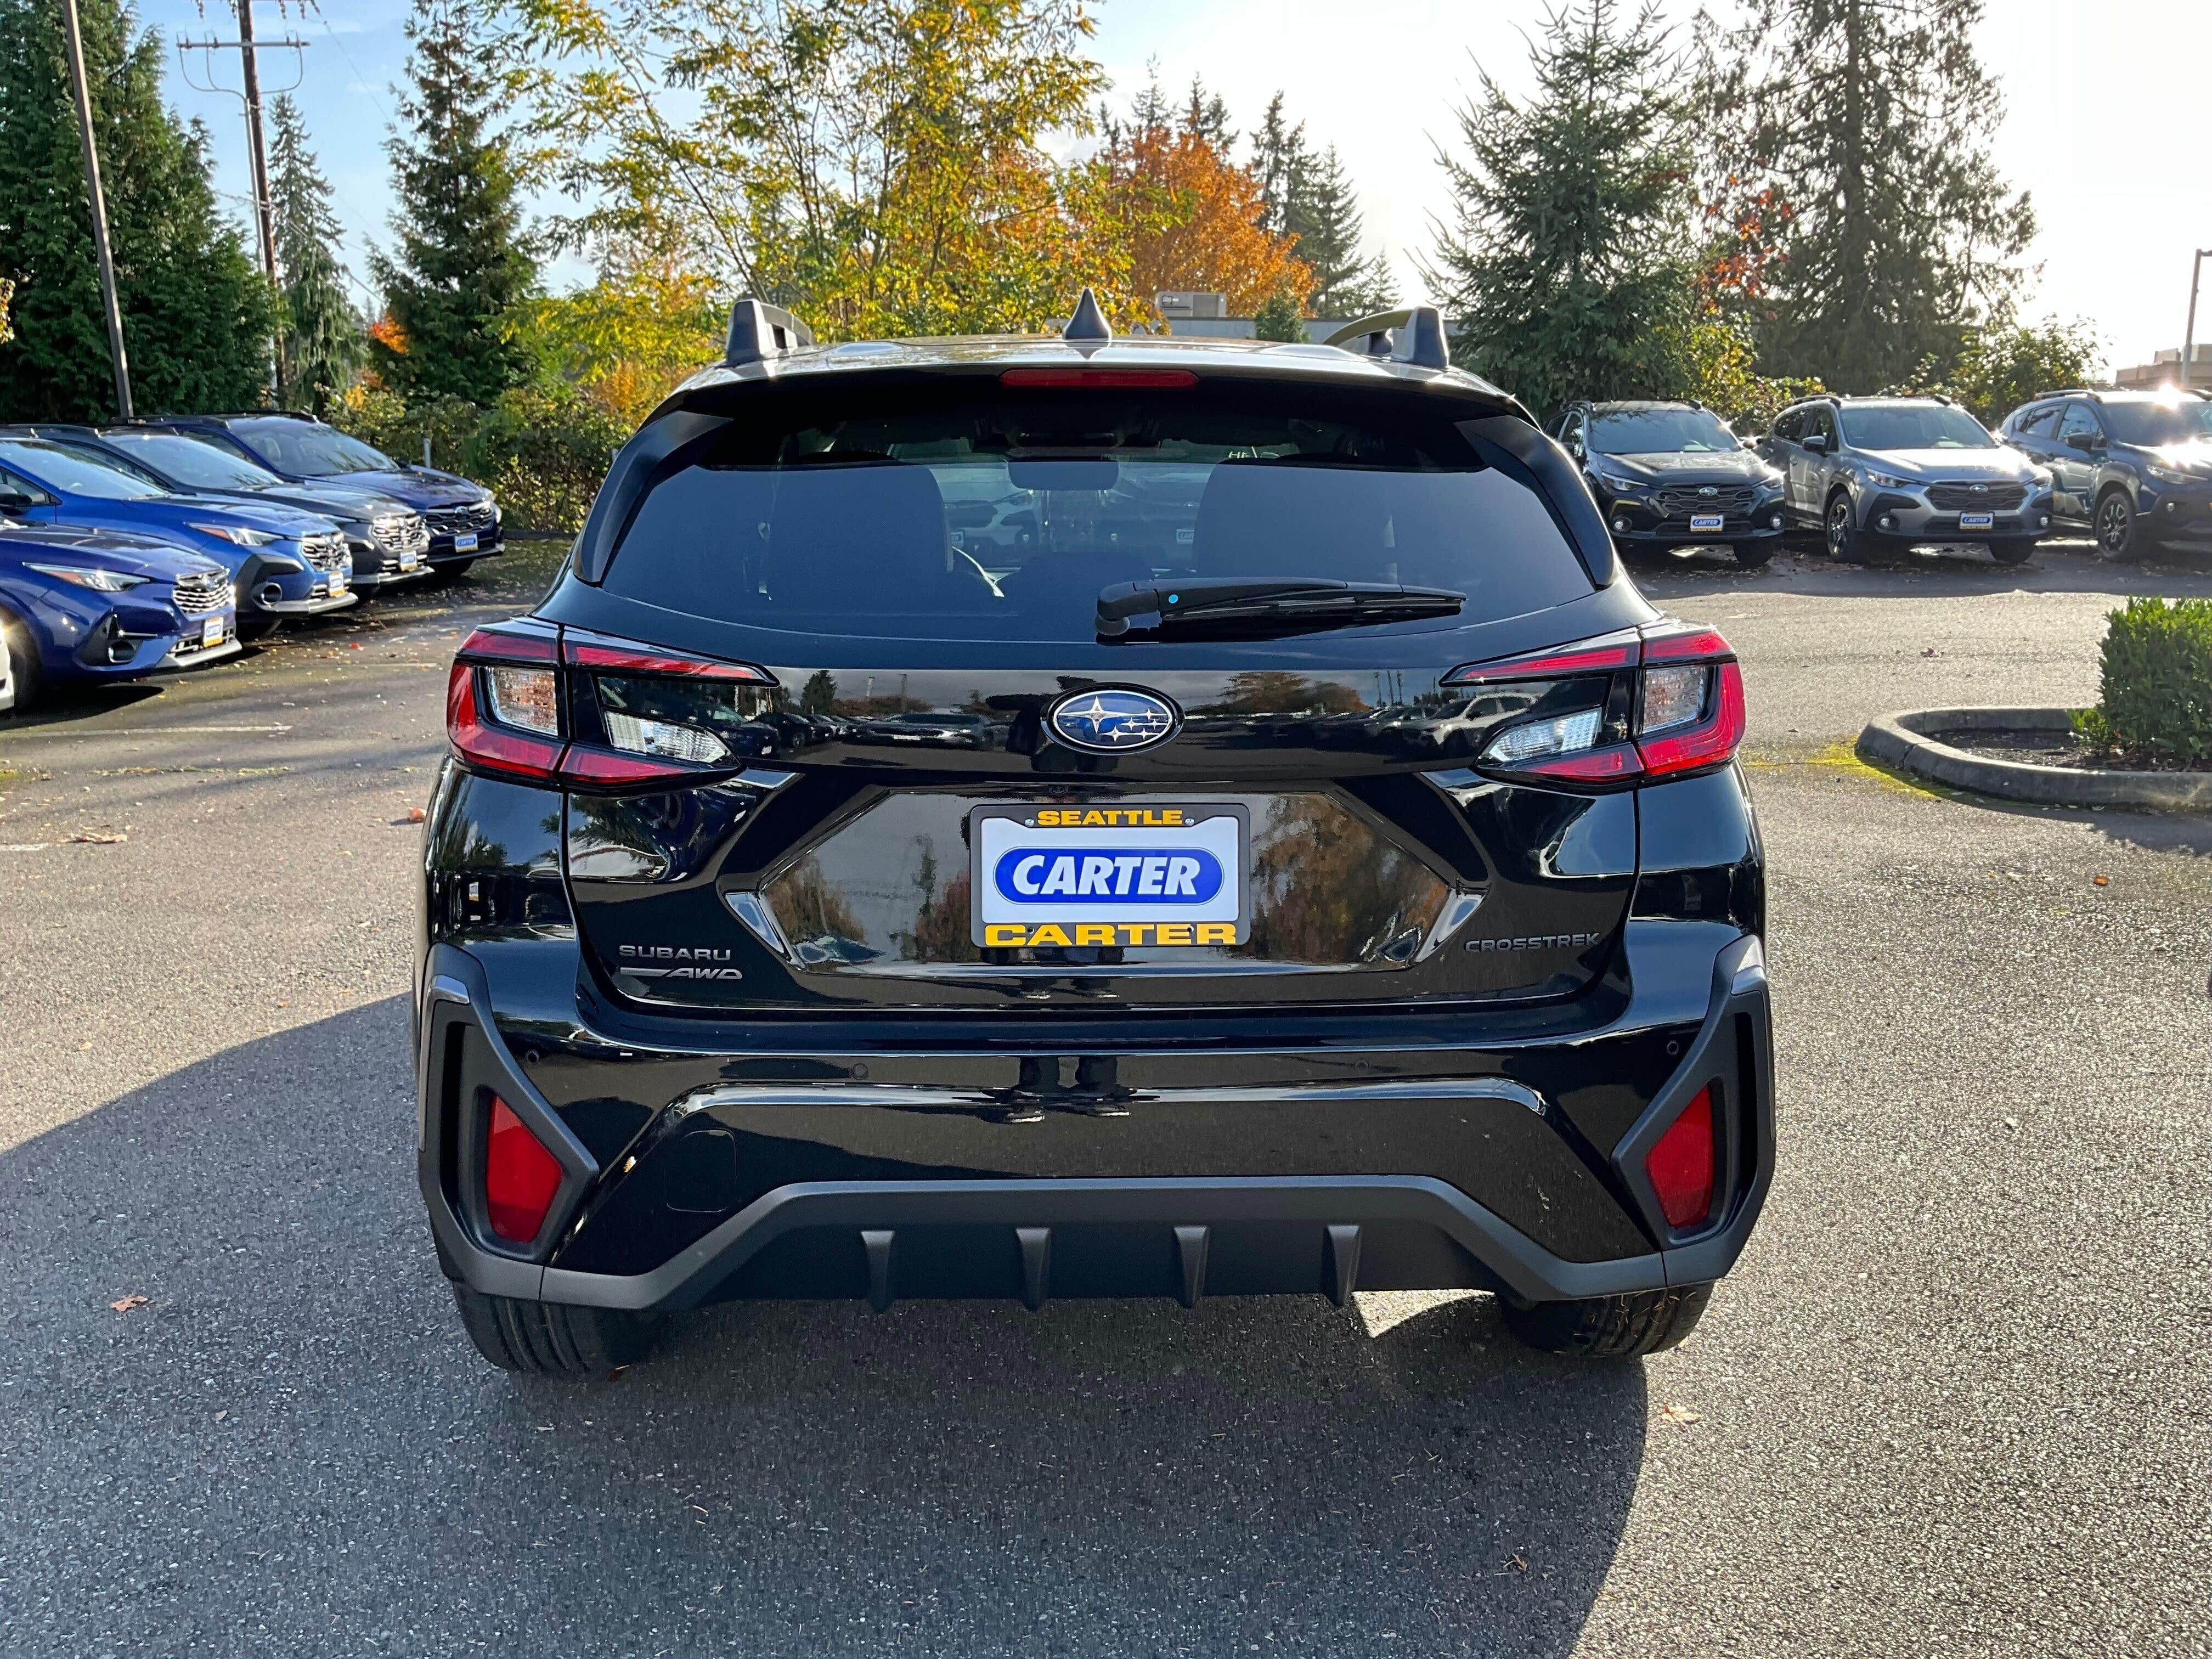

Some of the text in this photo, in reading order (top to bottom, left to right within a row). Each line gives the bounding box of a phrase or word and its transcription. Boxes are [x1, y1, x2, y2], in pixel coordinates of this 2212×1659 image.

[1037, 810, 1183, 826] SEATTLE
[1012, 855, 1201, 895] CARTER
[984, 923, 1237, 946] CARTER
[1465, 933, 1600, 952] CROSSTREK
[619, 945, 731, 961] SUBARU
[665, 967, 743, 980] AWD
